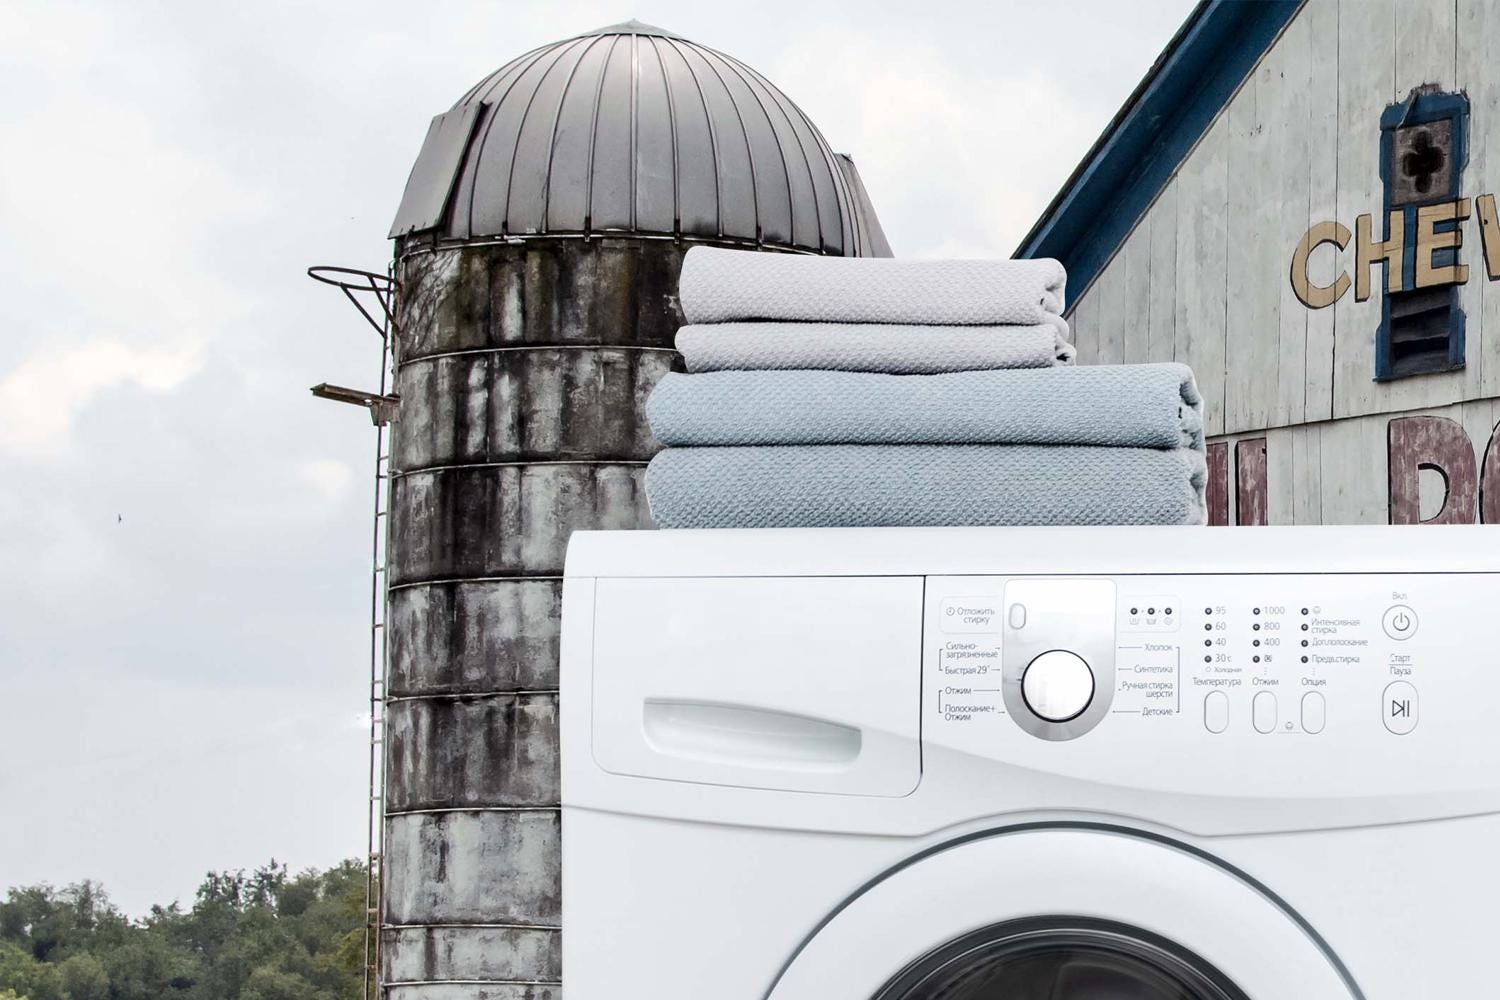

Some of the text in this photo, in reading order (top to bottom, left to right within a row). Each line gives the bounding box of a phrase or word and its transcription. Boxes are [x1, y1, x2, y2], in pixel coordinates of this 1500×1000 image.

[1215, 606, 1226, 614] 95
[1264, 606, 1285, 614] 1000
[963, 616, 991, 625] стирку
[1215, 621, 1226, 630] 60
[1264, 621, 1281, 630] 800
[1215, 637, 1226, 645] 40
[1264, 637, 1281, 645] 400
[1134, 664, 1173, 672] Синтетика
[1192, 676, 1242, 687] Температура
[1252, 676, 1279, 685] Отжим
[945, 686, 972, 695] Отжим
[1142, 706, 1173, 717] Детские
[945, 712, 971, 721] Отжим
